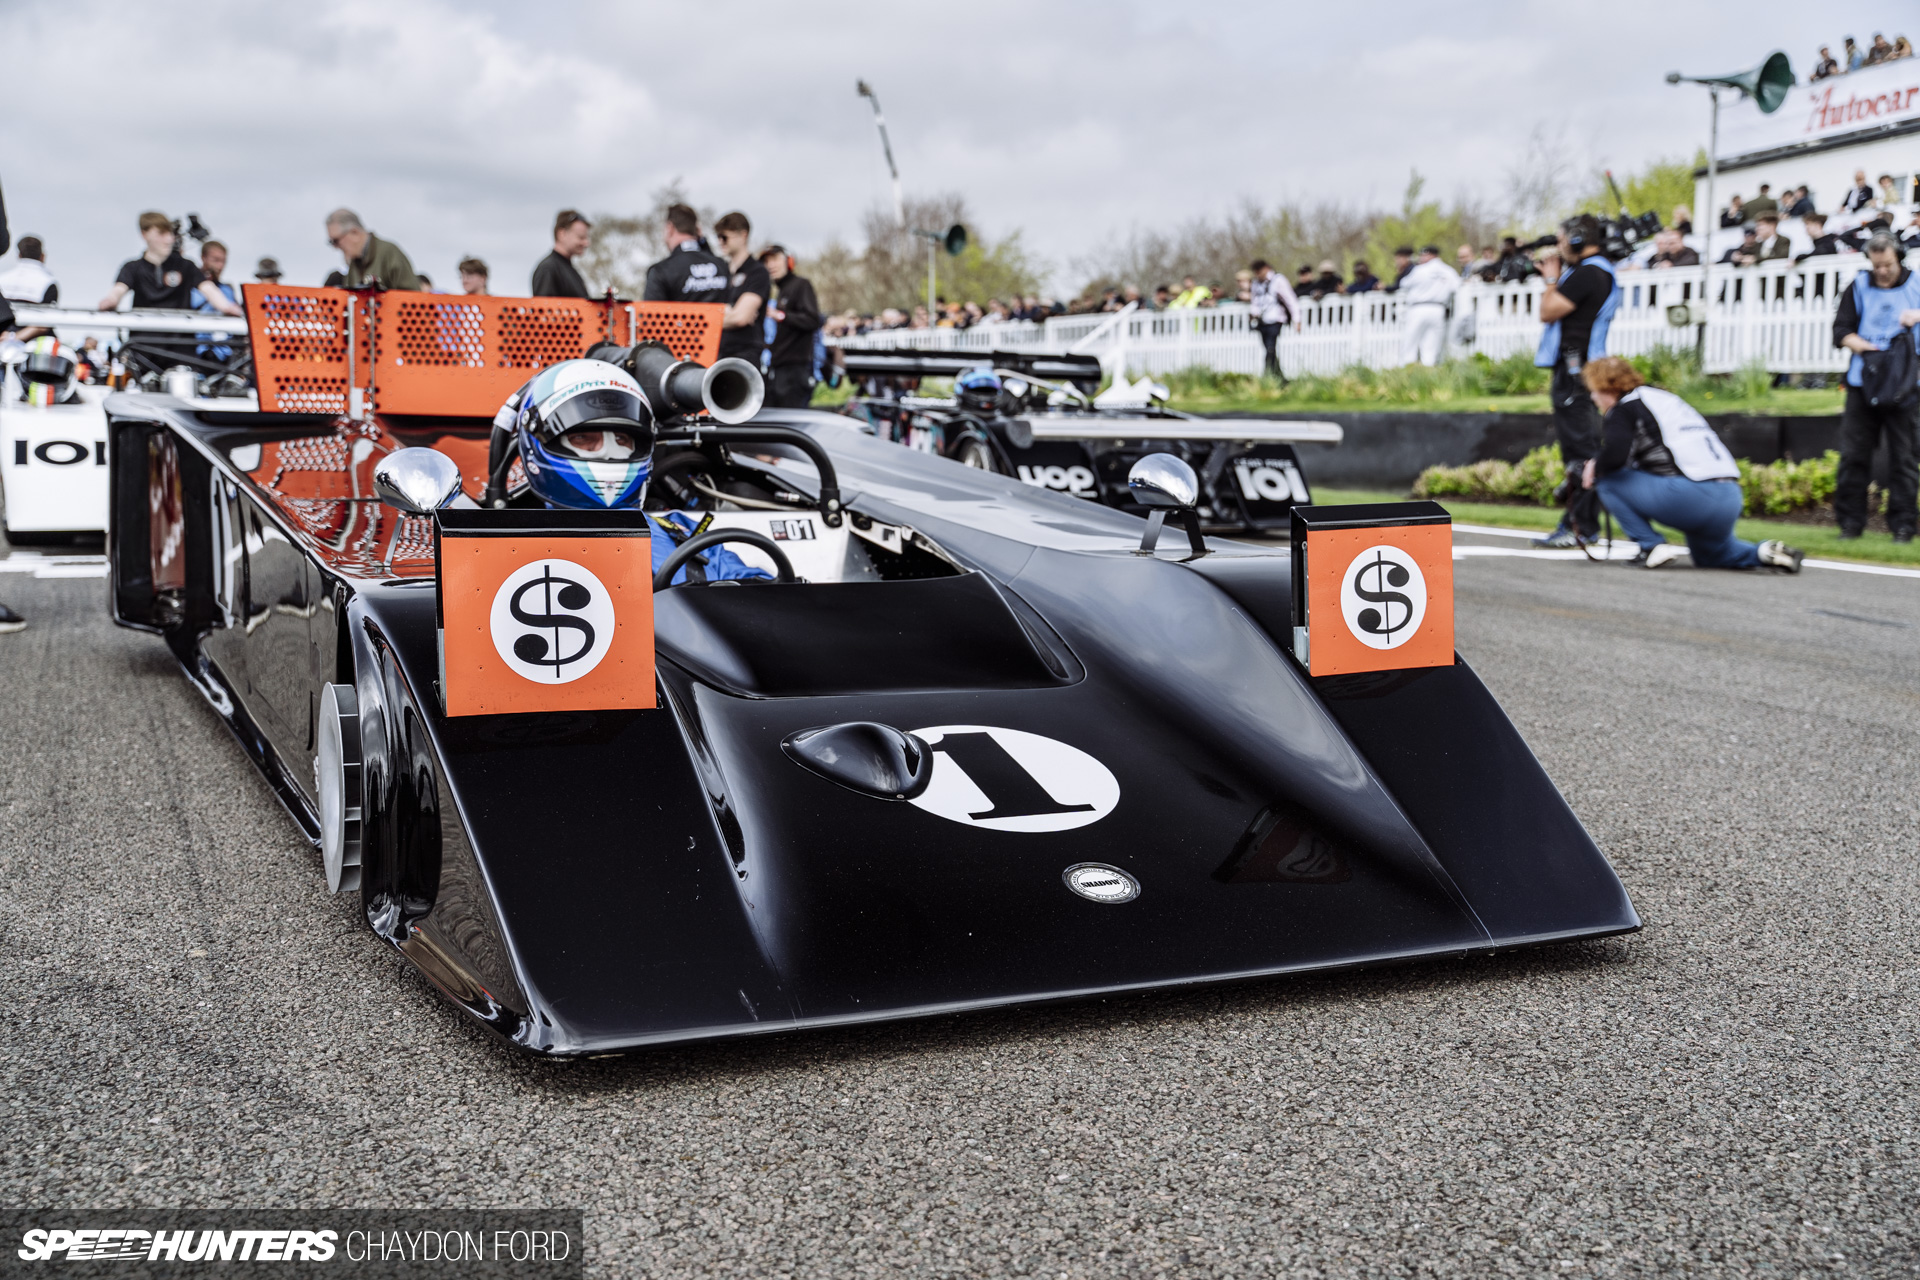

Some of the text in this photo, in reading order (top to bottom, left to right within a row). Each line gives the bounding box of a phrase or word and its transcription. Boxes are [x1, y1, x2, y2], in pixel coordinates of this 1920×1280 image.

[1807, 85, 1919, 133] Autocar
[549, 384, 579, 408] Grand
[580, 380, 606, 391] Prix
[785, 519, 815, 540] 01
[930, 732, 1096, 820] 1
[1080, 879, 1120, 888] SHADOW
